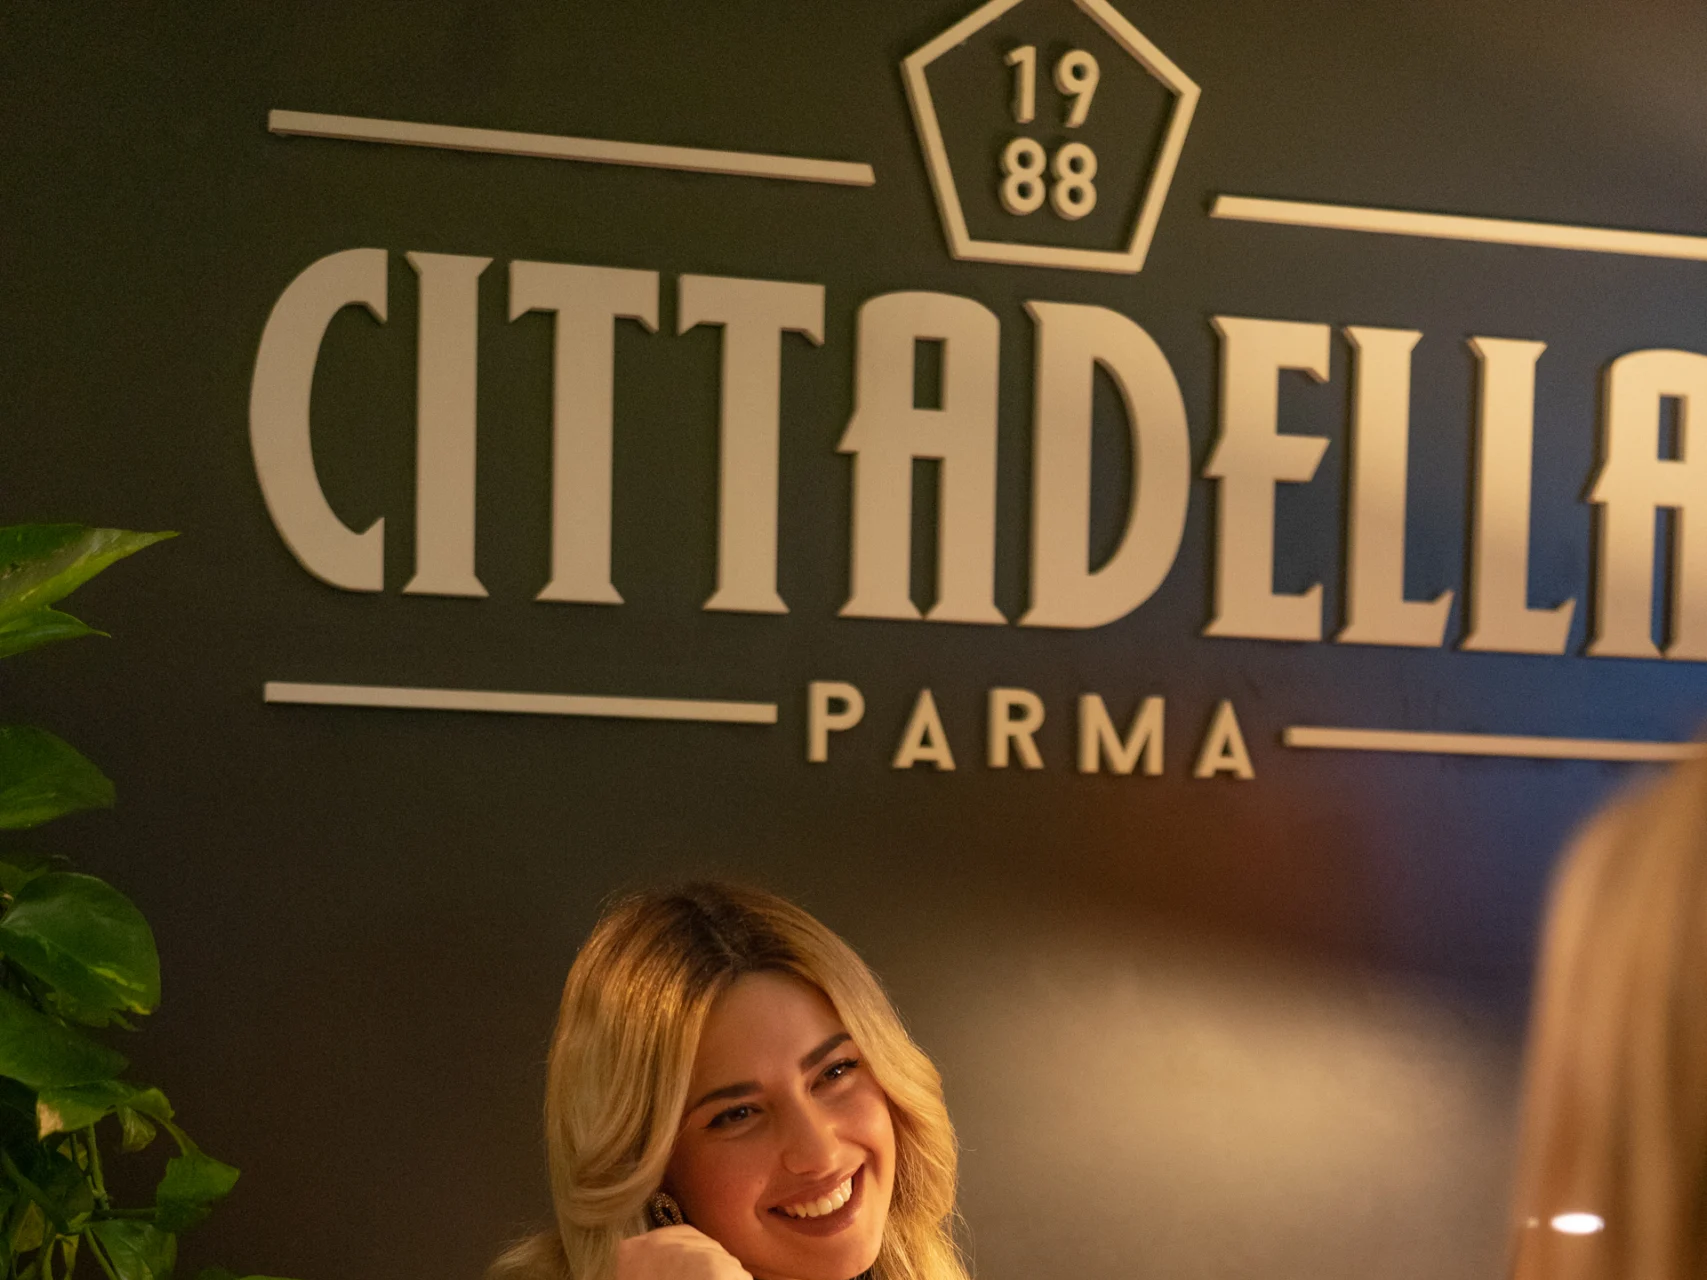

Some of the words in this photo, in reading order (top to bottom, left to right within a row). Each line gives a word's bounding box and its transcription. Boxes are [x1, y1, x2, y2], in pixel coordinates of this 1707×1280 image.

[1004, 44, 1101, 128] 19
[1001, 136, 1099, 220] 88
[249, 247, 1707, 661] CITTADELLA
[806, 680, 1256, 780] PARMA
